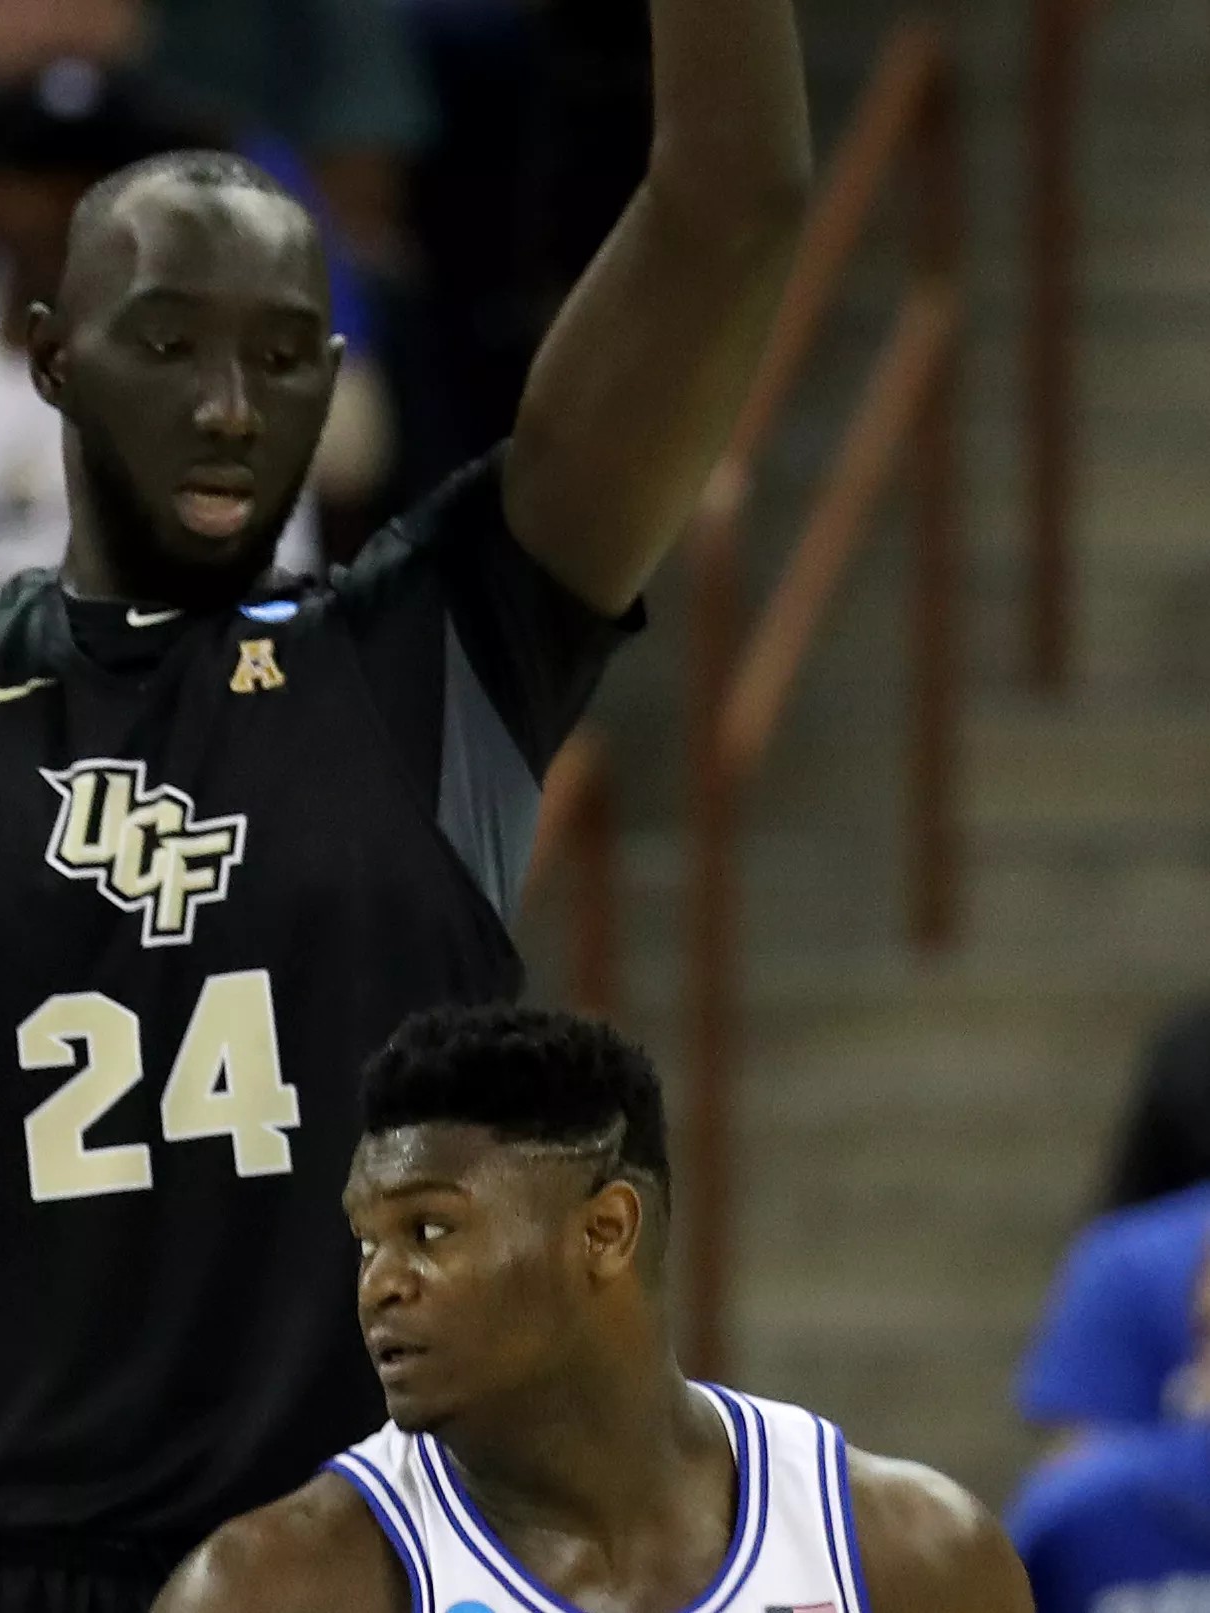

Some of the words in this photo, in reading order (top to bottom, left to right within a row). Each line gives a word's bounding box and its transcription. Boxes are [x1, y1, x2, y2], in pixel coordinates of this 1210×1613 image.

[230, 638, 286, 692] A
[39, 758, 247, 948] UCF
[16, 969, 301, 1202] 24
